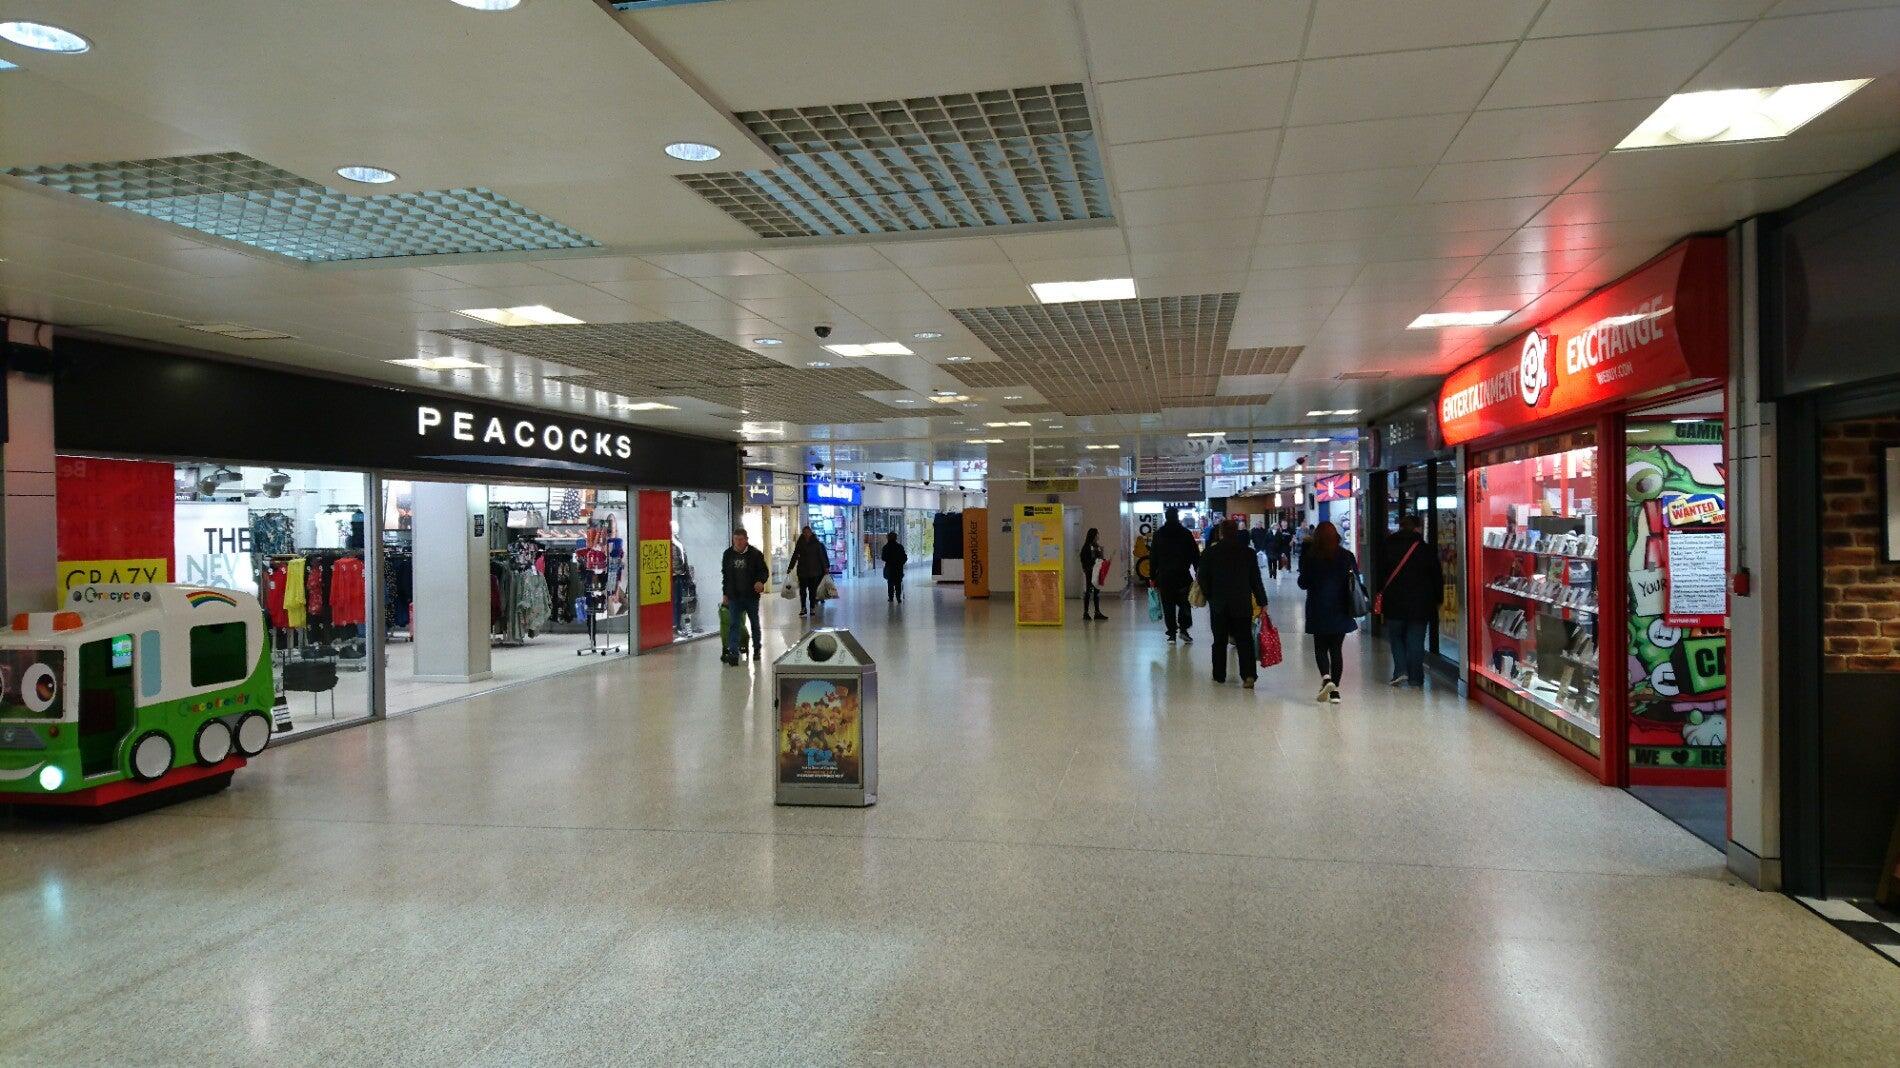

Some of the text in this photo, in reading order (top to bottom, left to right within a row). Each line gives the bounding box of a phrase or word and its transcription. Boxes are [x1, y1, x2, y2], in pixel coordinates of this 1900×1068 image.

[1442, 366, 1519, 423] ENTERTAINMENT
[1566, 296, 1664, 376] EXCHANGE
[417, 406, 632, 459] PEACOCKS
[1672, 501, 1715, 520] WANTED
[203, 527, 251, 554] THE
[1635, 749, 1660, 765] WE
